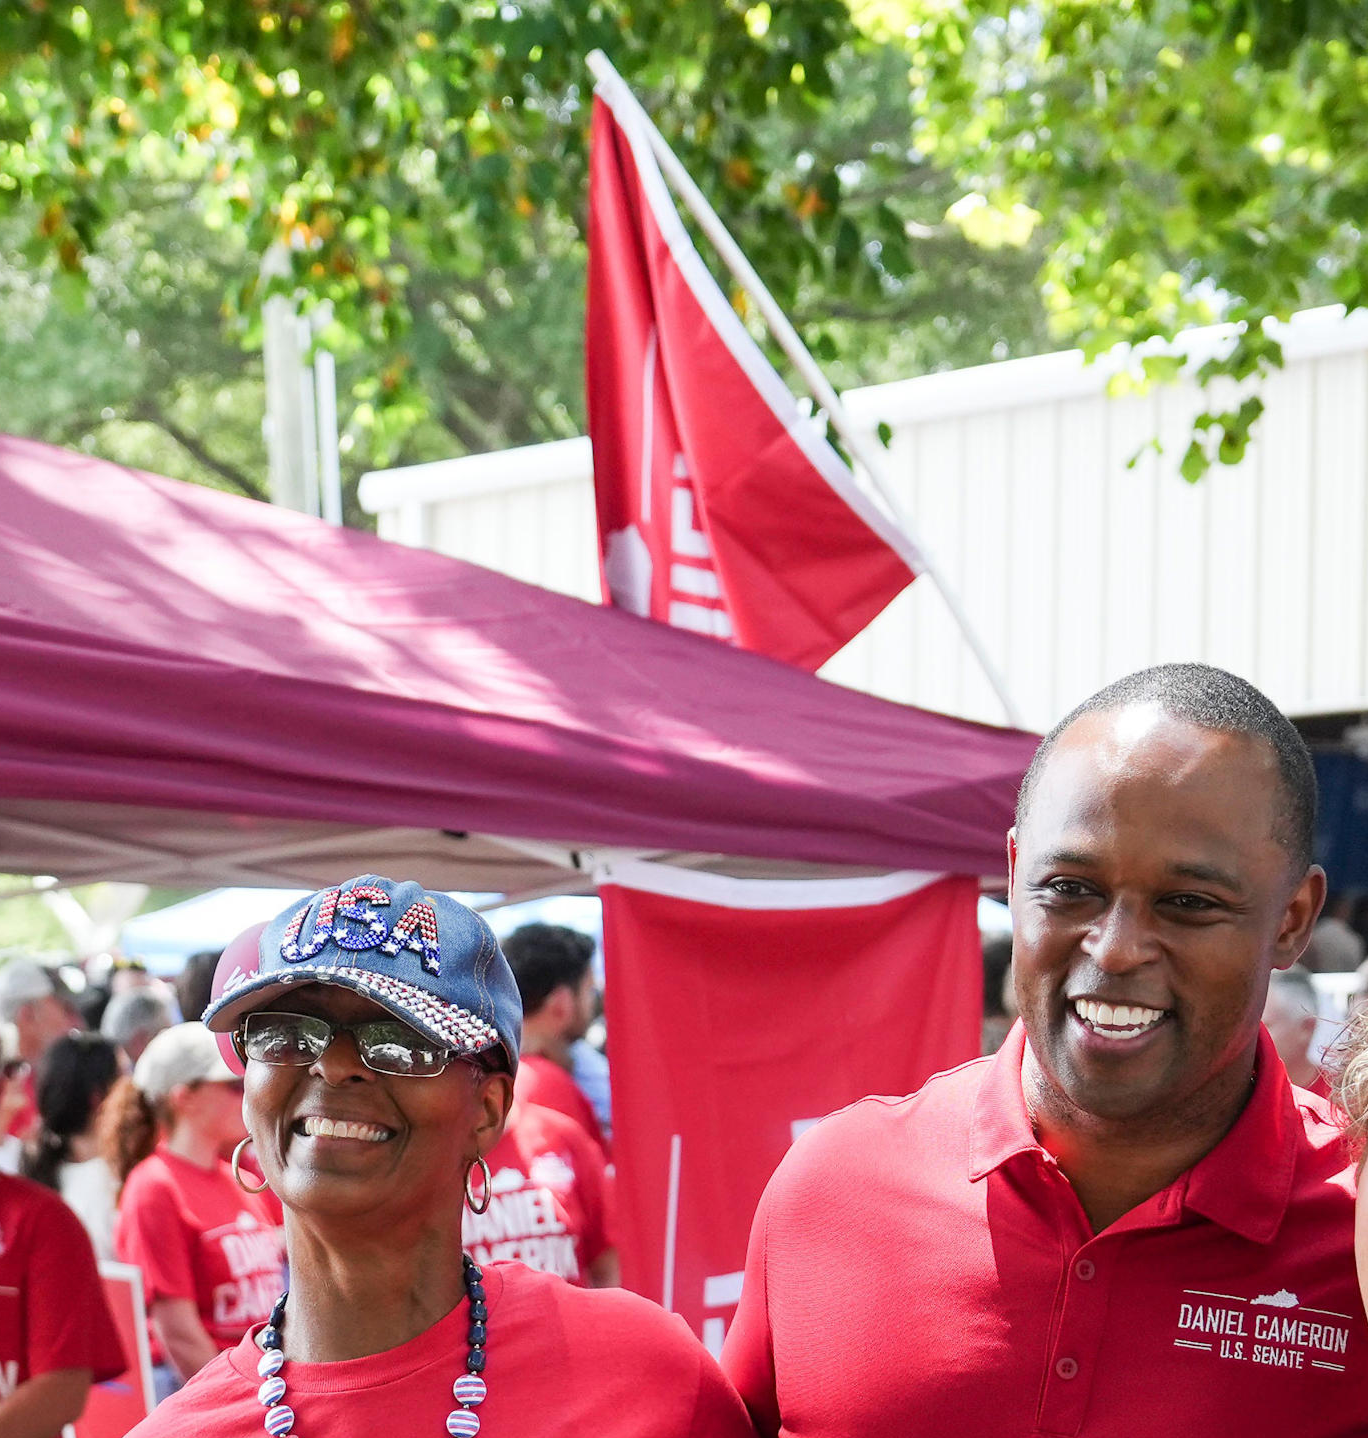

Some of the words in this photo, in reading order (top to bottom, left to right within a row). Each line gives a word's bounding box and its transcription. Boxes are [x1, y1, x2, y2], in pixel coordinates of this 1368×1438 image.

[281, 886, 441, 977] USA
[1178, 1304, 1248, 1336] DANIEL
[1255, 1315, 1349, 1354] CAMERON
[1220, 1340, 1247, 1361] U.S.
[1252, 1345, 1305, 1369] SENATE
